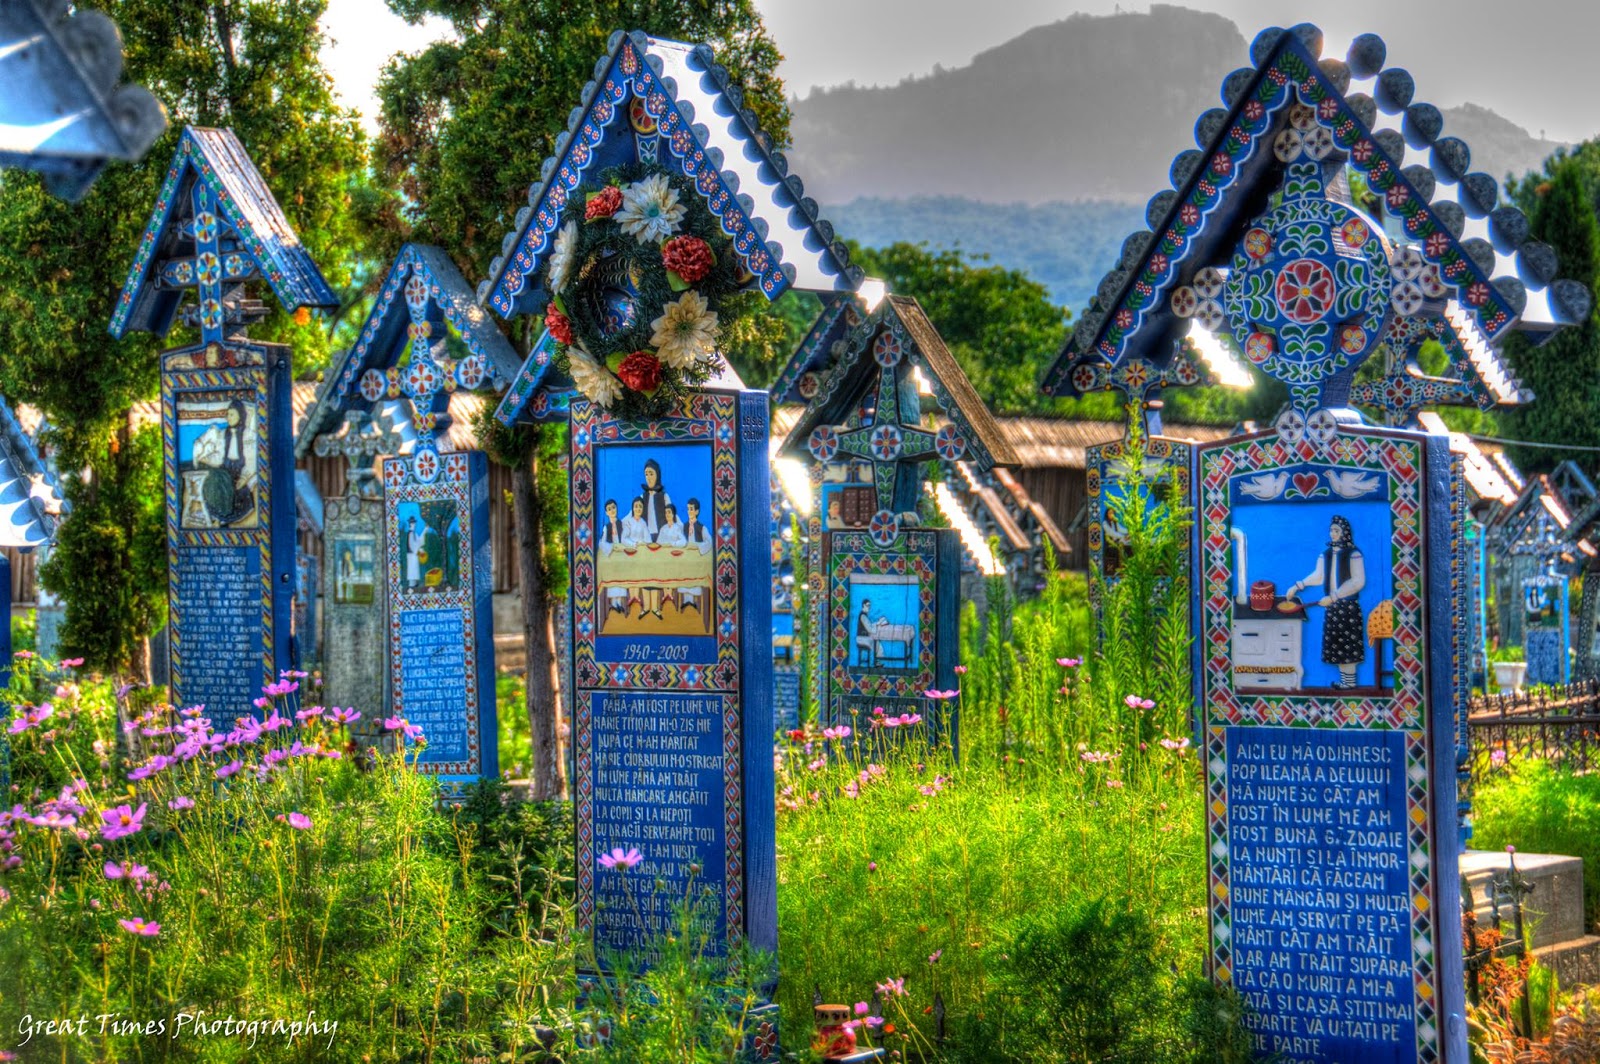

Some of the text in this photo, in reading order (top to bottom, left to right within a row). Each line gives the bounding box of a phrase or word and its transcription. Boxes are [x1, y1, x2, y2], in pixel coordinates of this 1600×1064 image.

[647, 699, 667, 714] FOST
[669, 699, 680, 714] PE
[706, 700, 720, 715] VIE
[680, 718, 694, 732] ZIS
[623, 734, 633, 750] CE
[1236, 741, 1391, 764] AICI EU MĂ ODIHNESC
[687, 755, 723, 771] STRIGAT
[1232, 764, 1257, 780] POP
[1314, 766, 1326, 783] A
[1231, 782, 1254, 801] MĂ
[1257, 785, 1317, 803] NUMESC
[1356, 789, 1380, 805] AM
[596, 805, 608, 819] LA
[610, 806, 632, 820] COPII
[646, 808, 658, 822] LA
[1232, 804, 1268, 821] FOST
[1273, 802, 1289, 823] ÎN
[1294, 807, 1333, 824] LUME
[1367, 810, 1391, 827] AM
[1232, 825, 1268, 842] FOST
[1233, 846, 1251, 861] LA
[1327, 850, 1347, 867] LA
[661, 862, 674, 877] AU
[1301, 866, 1322, 886] CĂ
[1325, 867, 1385, 890] FĂCEAM
[1233, 888, 1269, 905] BUNE
[1365, 892, 1410, 913] MULTĂ
[1234, 908, 1266, 924] LUME
[1270, 910, 1296, 926] AM
[1298, 912, 1351, 930] SERVIT
[1357, 914, 1374, 932] PE
[1235, 926, 1274, 946] MÂNT
[1315, 933, 1340, 951] AM
[1345, 930, 1394, 955] TRĂIT
[1235, 949, 1264, 967] DAR
[1269, 952, 1291, 969] AM
[1298, 951, 1345, 973] TRĂIT
[1259, 969, 1280, 990] CĂ
[1282, 974, 1293, 990] O
[1297, 973, 1344, 994] MURIT
[1346, 979, 1357, 995] A
[1362, 978, 1396, 998] MI-A
[1296, 994, 1340, 1015] CASĂ
[1386, 1003, 1412, 1021] MAI
[1304, 1014, 1325, 1036] VĂ
[1382, 1023, 1400, 1042] PE
